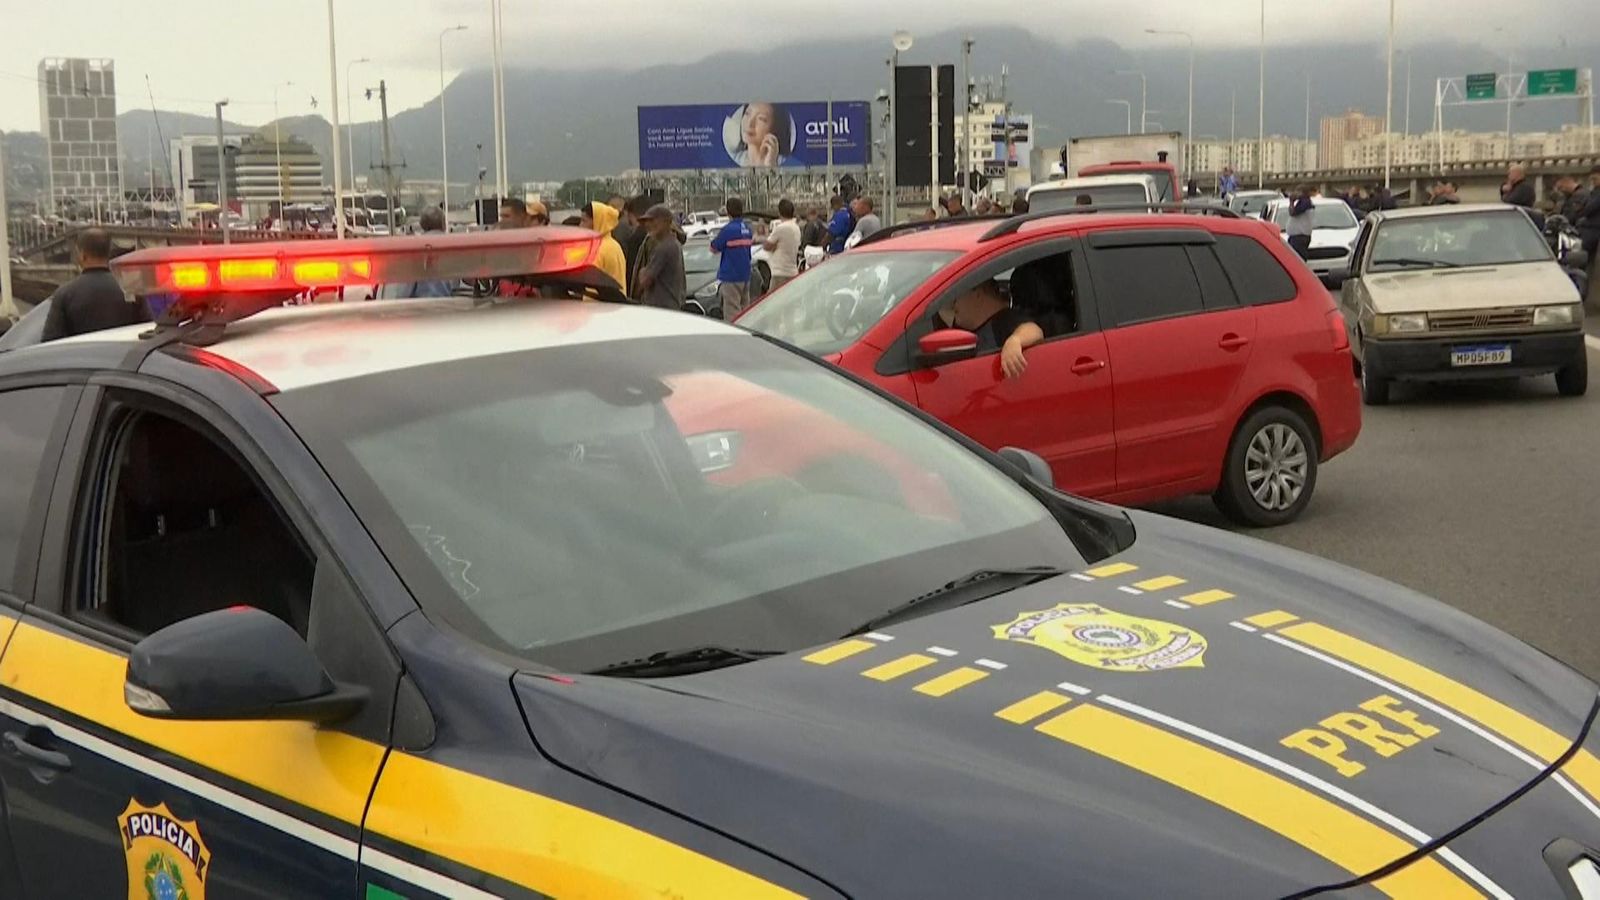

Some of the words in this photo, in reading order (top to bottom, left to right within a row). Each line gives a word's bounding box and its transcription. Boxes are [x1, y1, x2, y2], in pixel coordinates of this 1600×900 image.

[805, 117, 850, 135] amil
[1279, 694, 1441, 778] PRF
[130, 813, 194, 860] POLÍCIA
